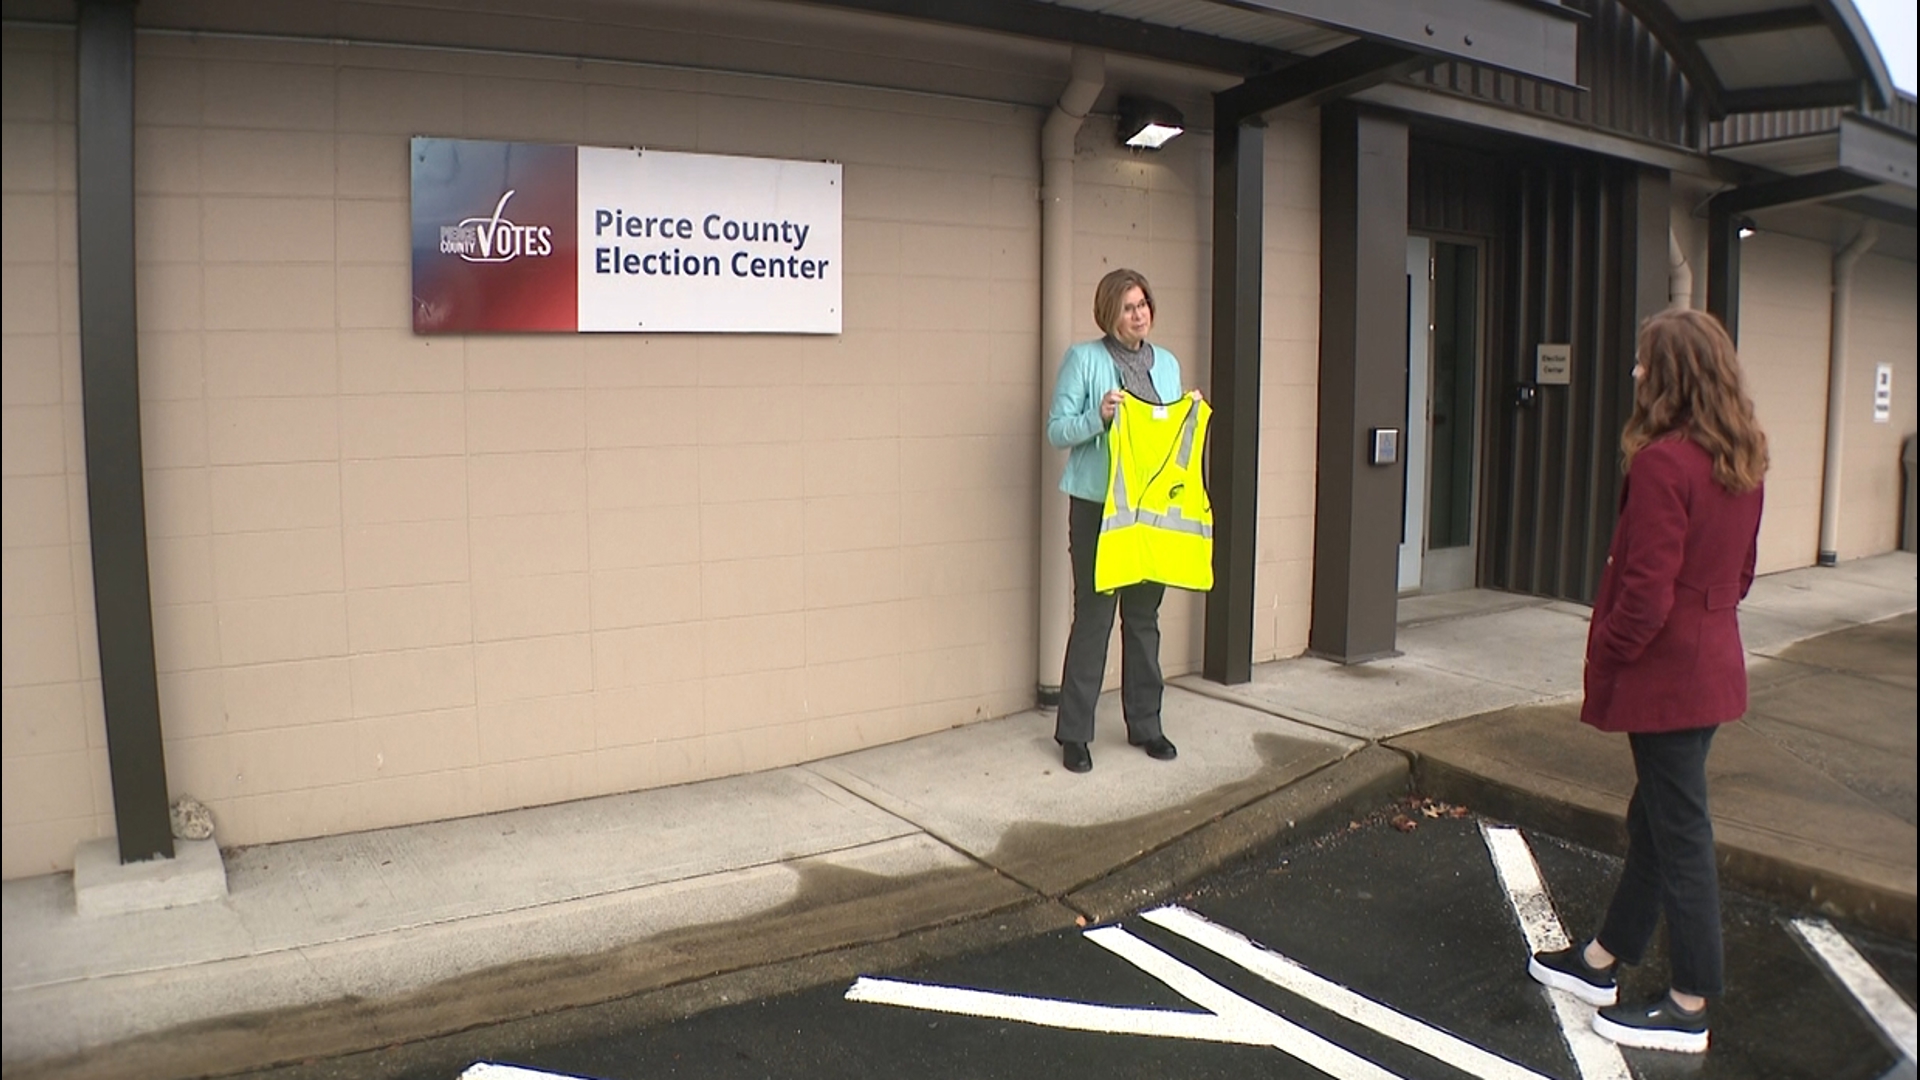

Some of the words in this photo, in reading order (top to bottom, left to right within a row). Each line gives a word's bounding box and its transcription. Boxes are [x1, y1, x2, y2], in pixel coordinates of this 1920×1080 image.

[477, 190, 552, 258] VOTES
[595, 208, 693, 239] Pierce
[702, 213, 810, 251] County
[440, 240, 476, 254] COUNTY
[595, 245, 721, 277] Election
[731, 251, 829, 280] Center
